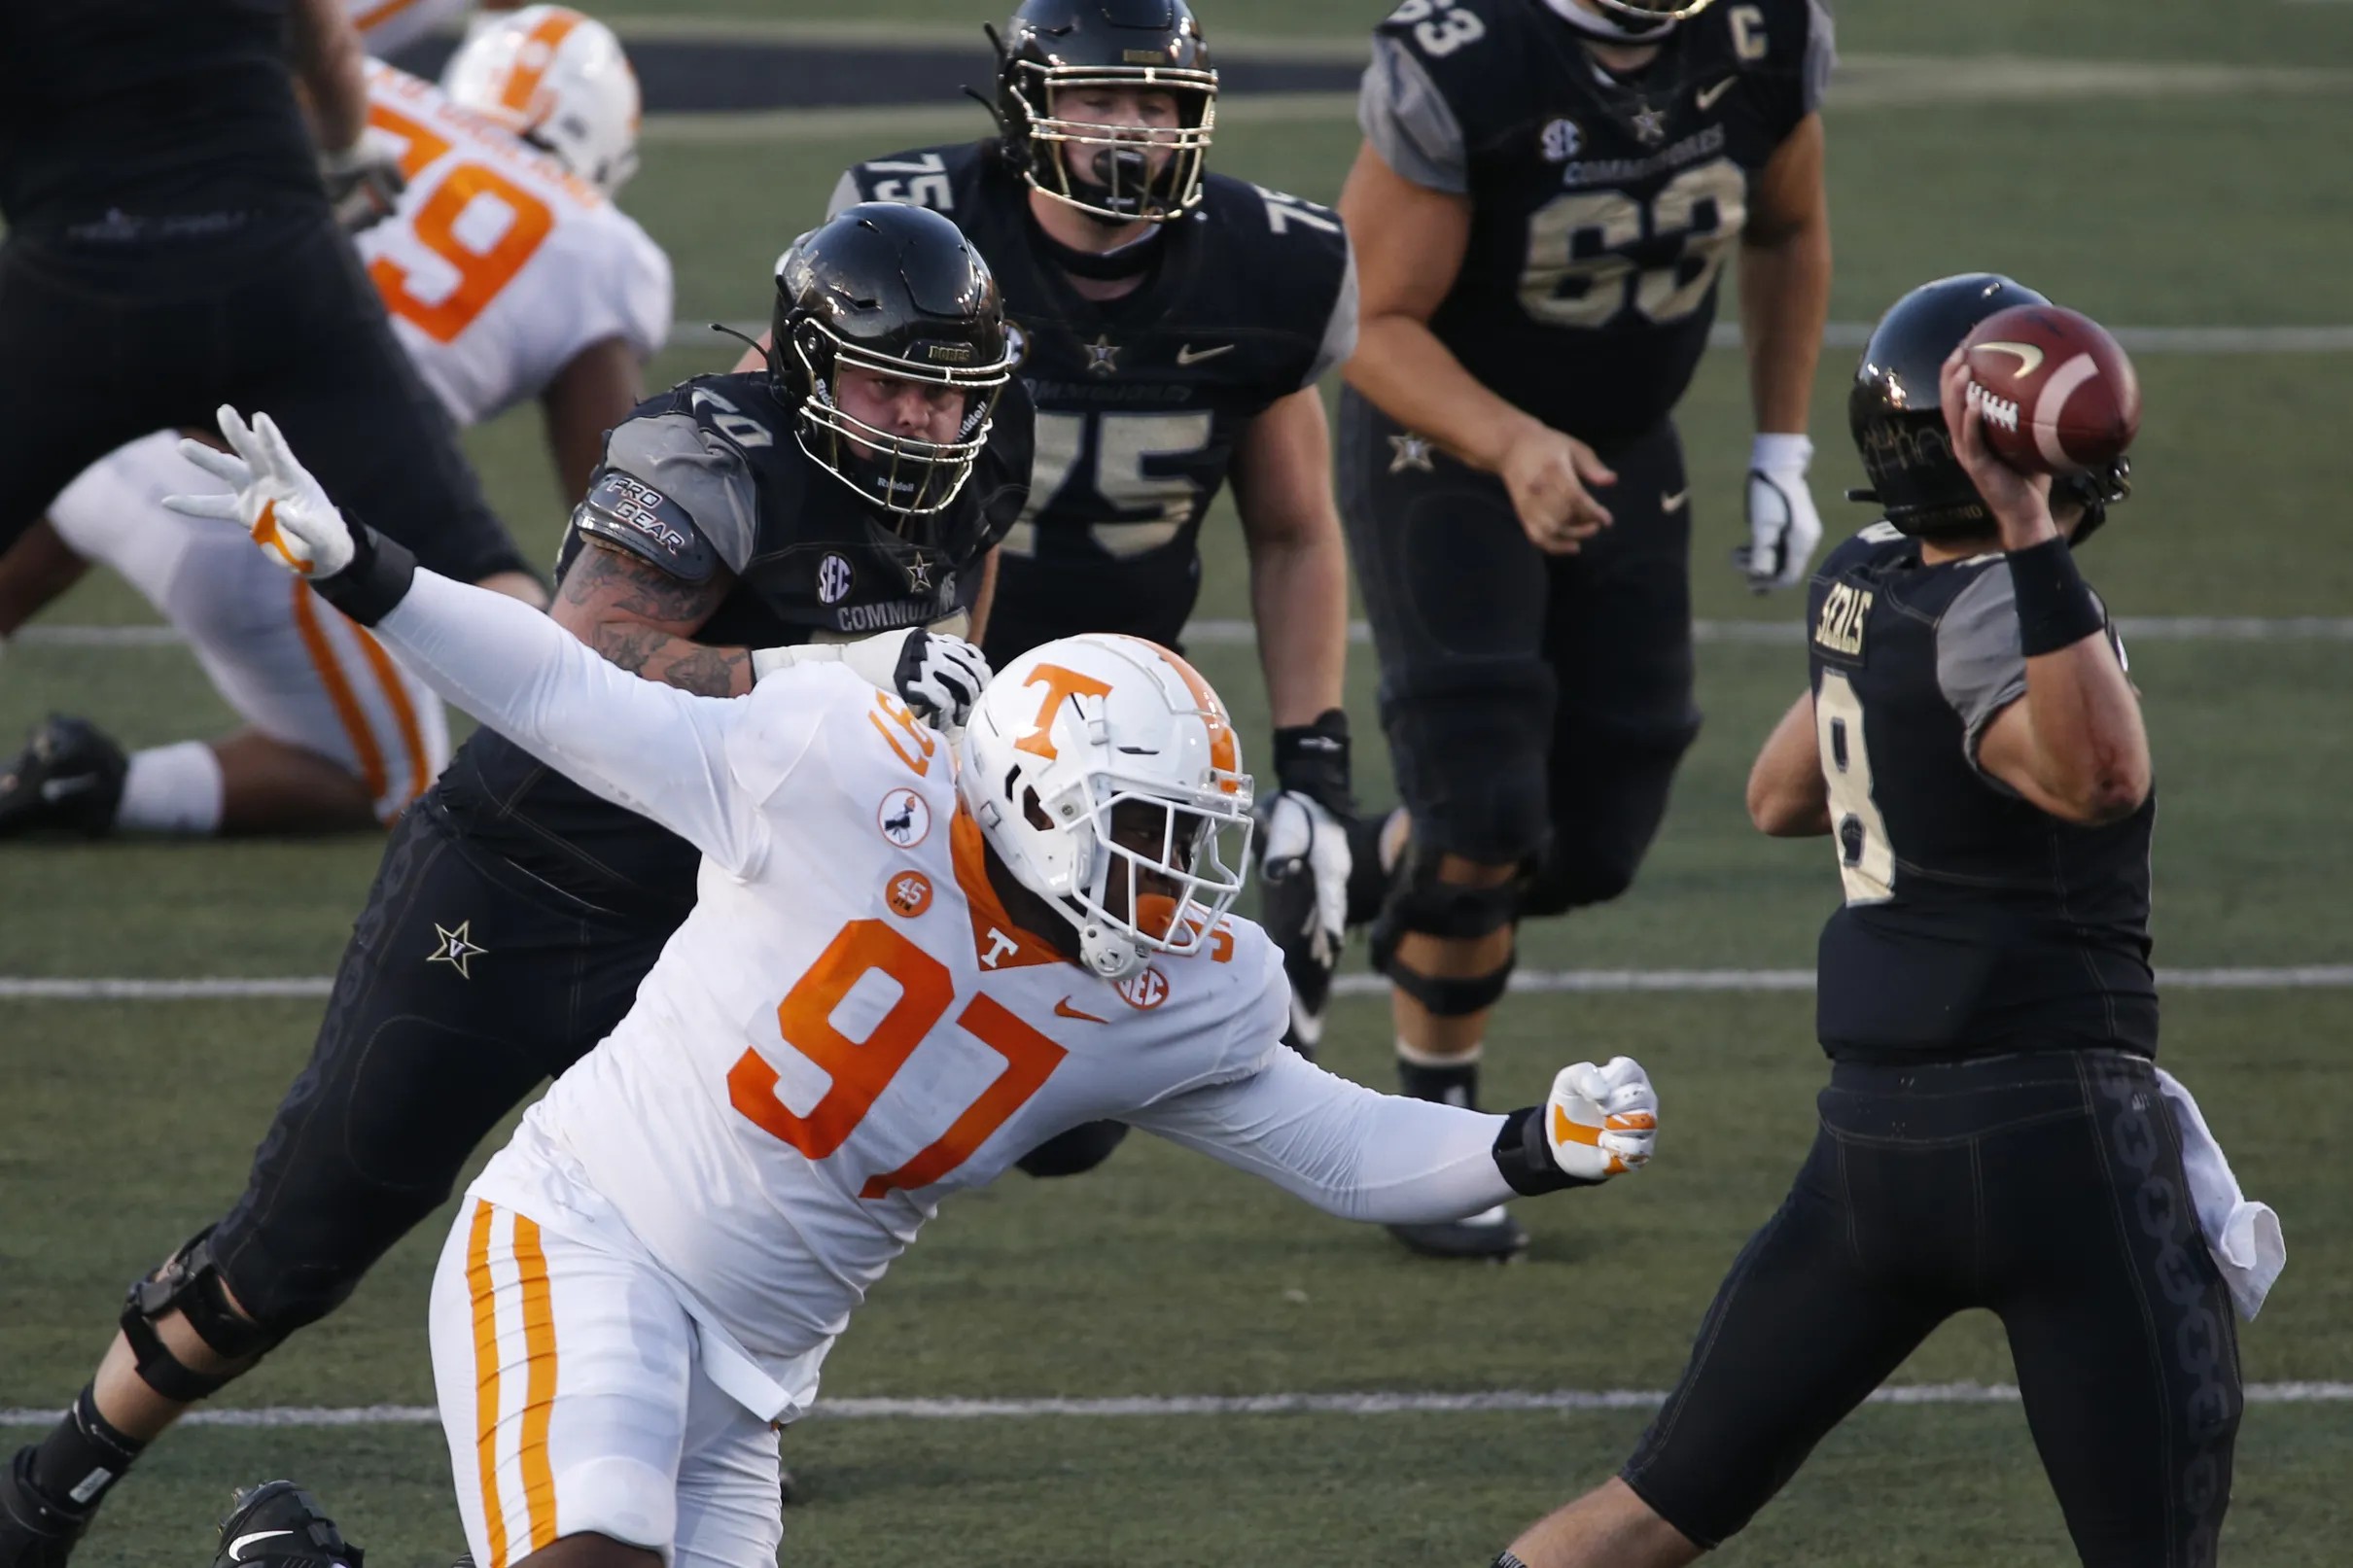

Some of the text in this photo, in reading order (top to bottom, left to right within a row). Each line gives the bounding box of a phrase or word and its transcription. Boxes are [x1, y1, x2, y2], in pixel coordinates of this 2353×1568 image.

[1728, 6, 1768, 59] C
[864, 153, 954, 210] 75
[1518, 156, 1747, 329] 63
[605, 477, 663, 509] PRO
[996, 411, 1214, 558] 75
[615, 501, 685, 557] GEAR
[819, 555, 851, 605] SEC
[1013, 662, 1113, 761] T
[1815, 666, 1896, 908] 8
[896, 878, 926, 905] 45
[981, 926, 1019, 968] T
[726, 918, 1069, 1200] 97
